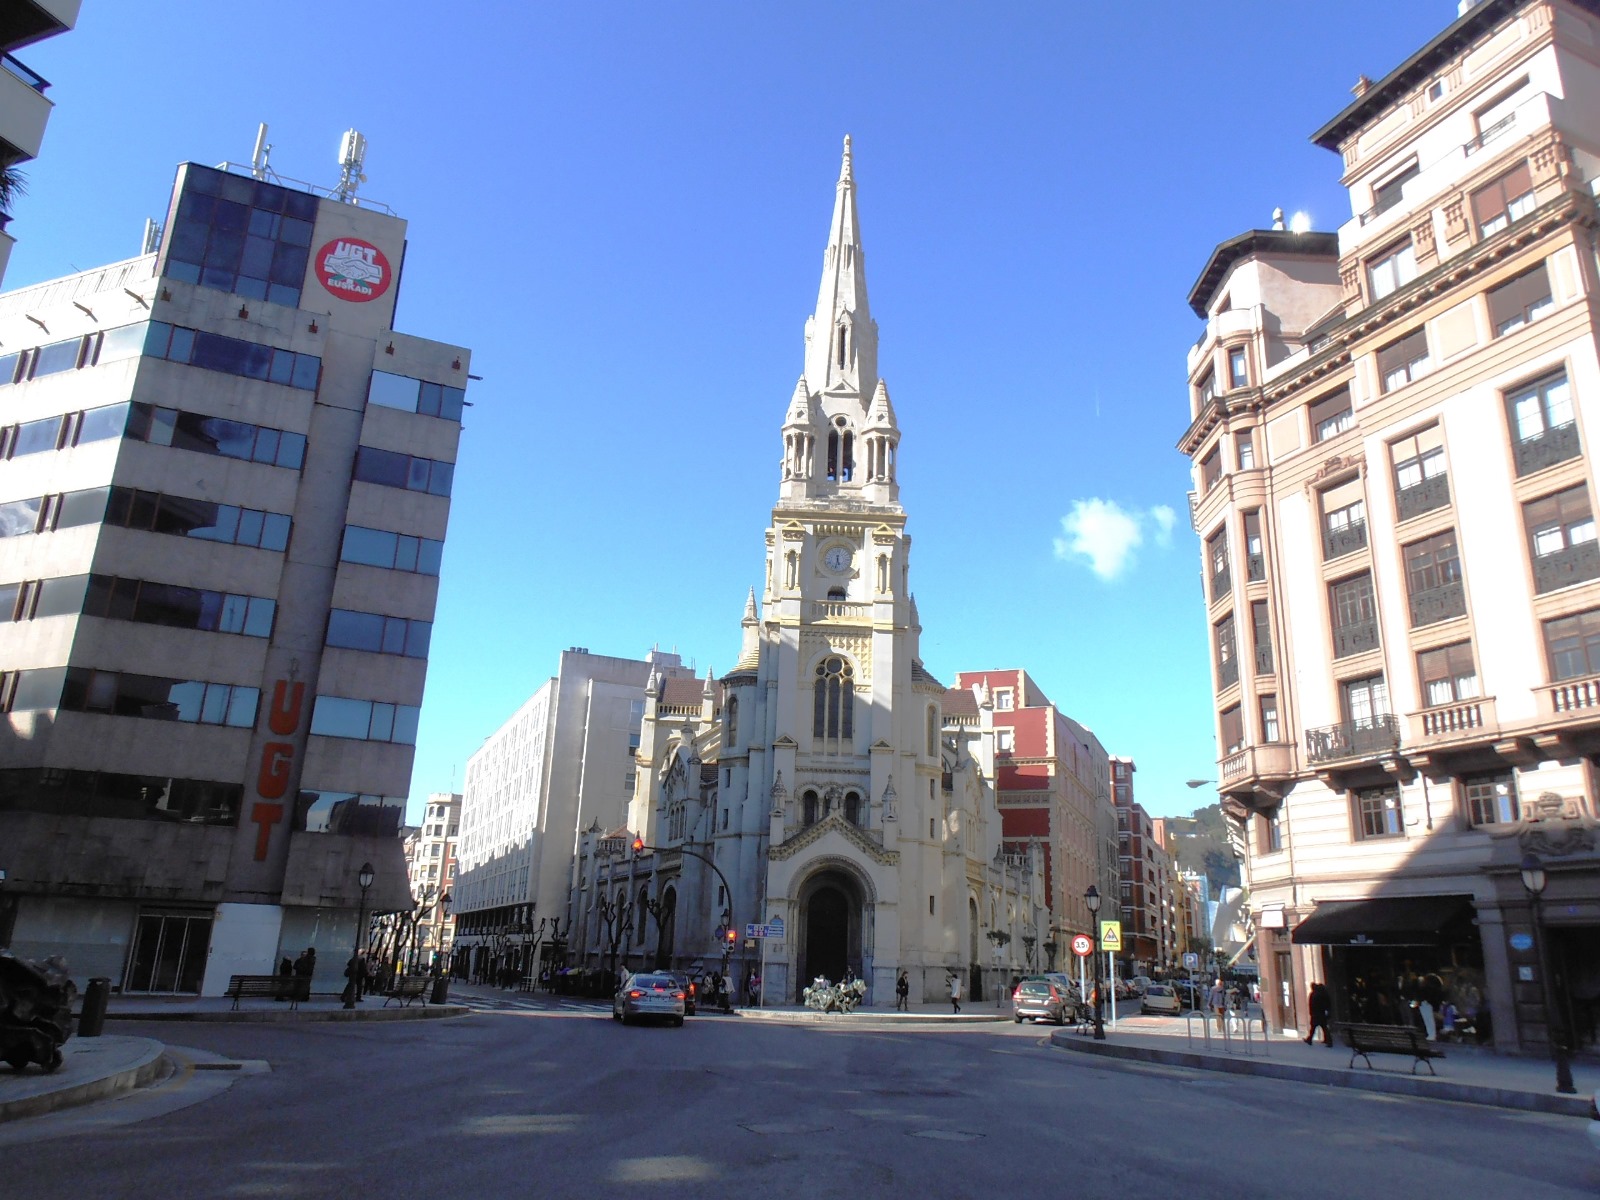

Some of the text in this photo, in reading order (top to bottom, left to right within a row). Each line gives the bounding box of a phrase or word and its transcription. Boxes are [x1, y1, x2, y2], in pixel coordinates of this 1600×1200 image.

[334, 241, 377, 264] UGT
[327, 278, 373, 296] EUSKADI
[250, 679, 305, 862] UGT
